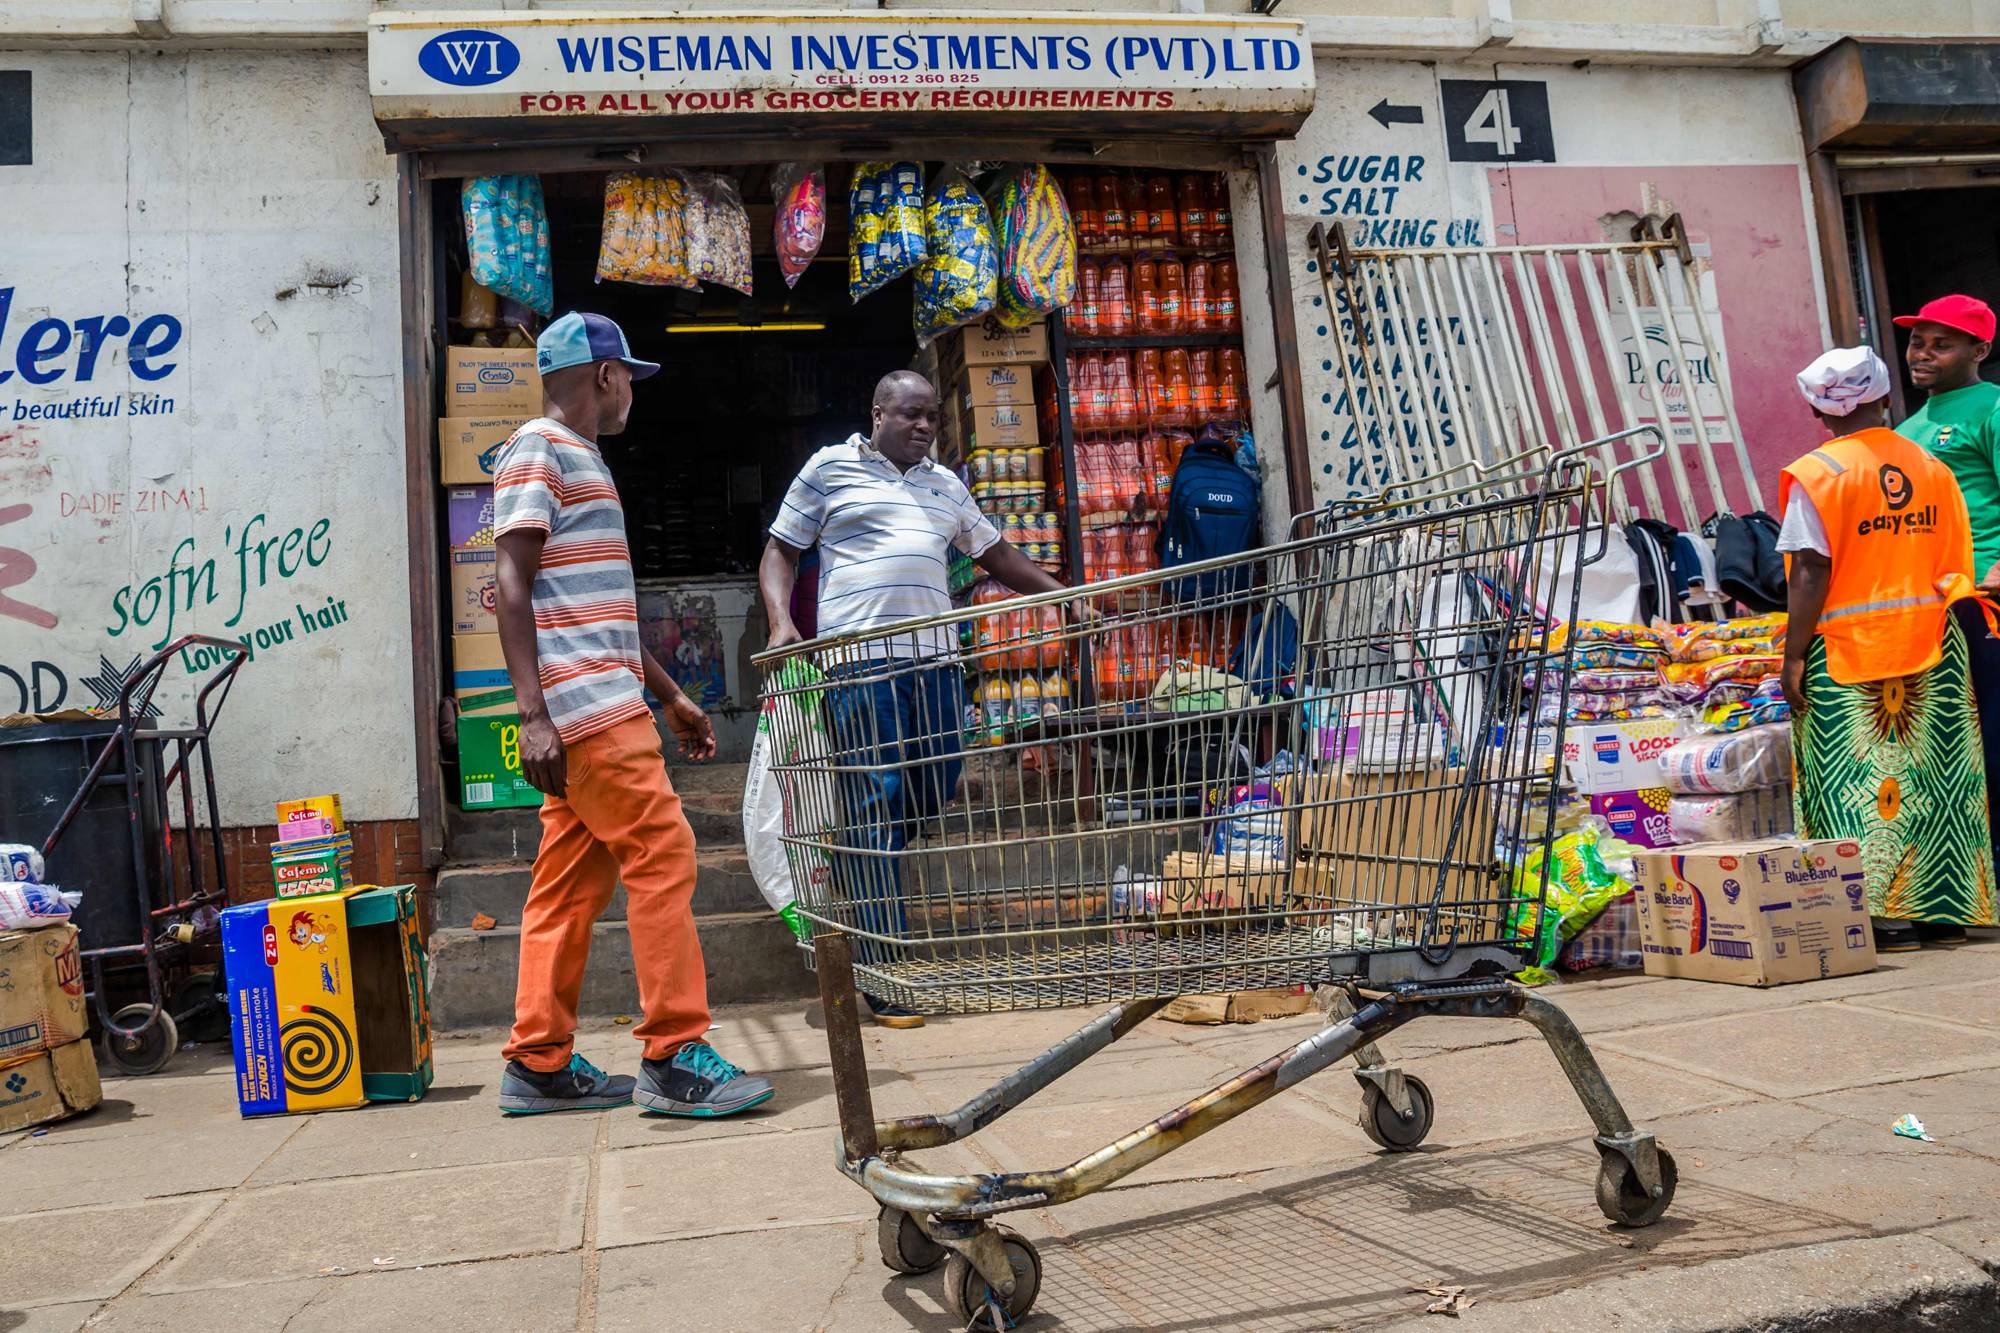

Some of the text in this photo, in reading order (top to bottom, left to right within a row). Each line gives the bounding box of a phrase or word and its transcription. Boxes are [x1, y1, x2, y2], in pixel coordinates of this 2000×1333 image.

[436, 40, 502, 75] WI
[557, 36, 771, 73] WISEMAN
[792, 35, 1091, 71] INVESTMENTS
[816, 73, 980, 84] CELL: 0912 360 825
[520, 90, 1174, 112] FOR ALL YOUR GROCERY REQUIREMENTS
[1464, 88, 1522, 155] 4
[1312, 155, 1426, 184] SUGAR
[1320, 186, 1399, 216] SALT
[13, 395, 120, 421] beautiful
[128, 394, 175, 416] skin
[1207, 493, 1233, 503] DOUD
[296, 596, 349, 634] hair
[1610, 812, 1634, 820] LOBELS
[278, 862, 329, 880] Cafemol
[1785, 865, 1838, 884] Blue Band
[1654, 892, 1693, 906] Blue Band
[252, 987, 270, 1101] ZENDEN micro-smoke
